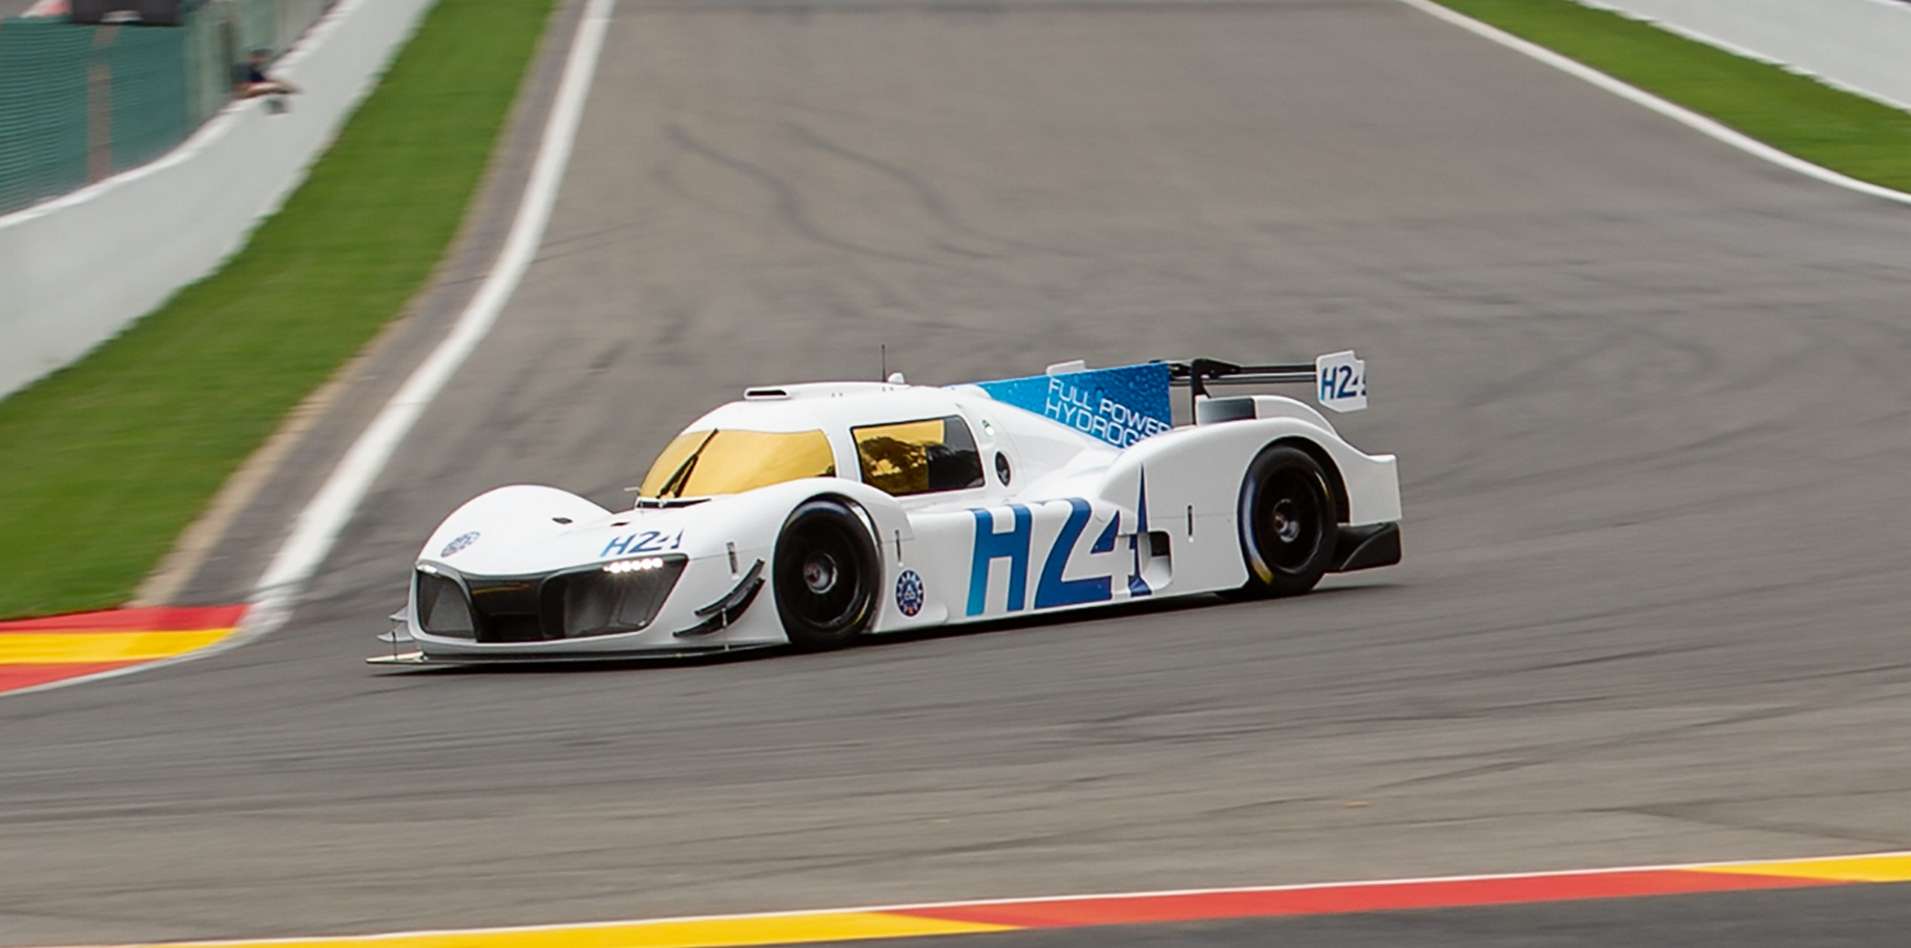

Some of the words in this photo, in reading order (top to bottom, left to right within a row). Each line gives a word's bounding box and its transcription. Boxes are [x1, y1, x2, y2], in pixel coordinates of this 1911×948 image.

[1048, 378, 1092, 411] FULL
[1044, 397, 1146, 449] HYDROG
[601, 529, 684, 558] H24
[966, 463, 1152, 617] H24
